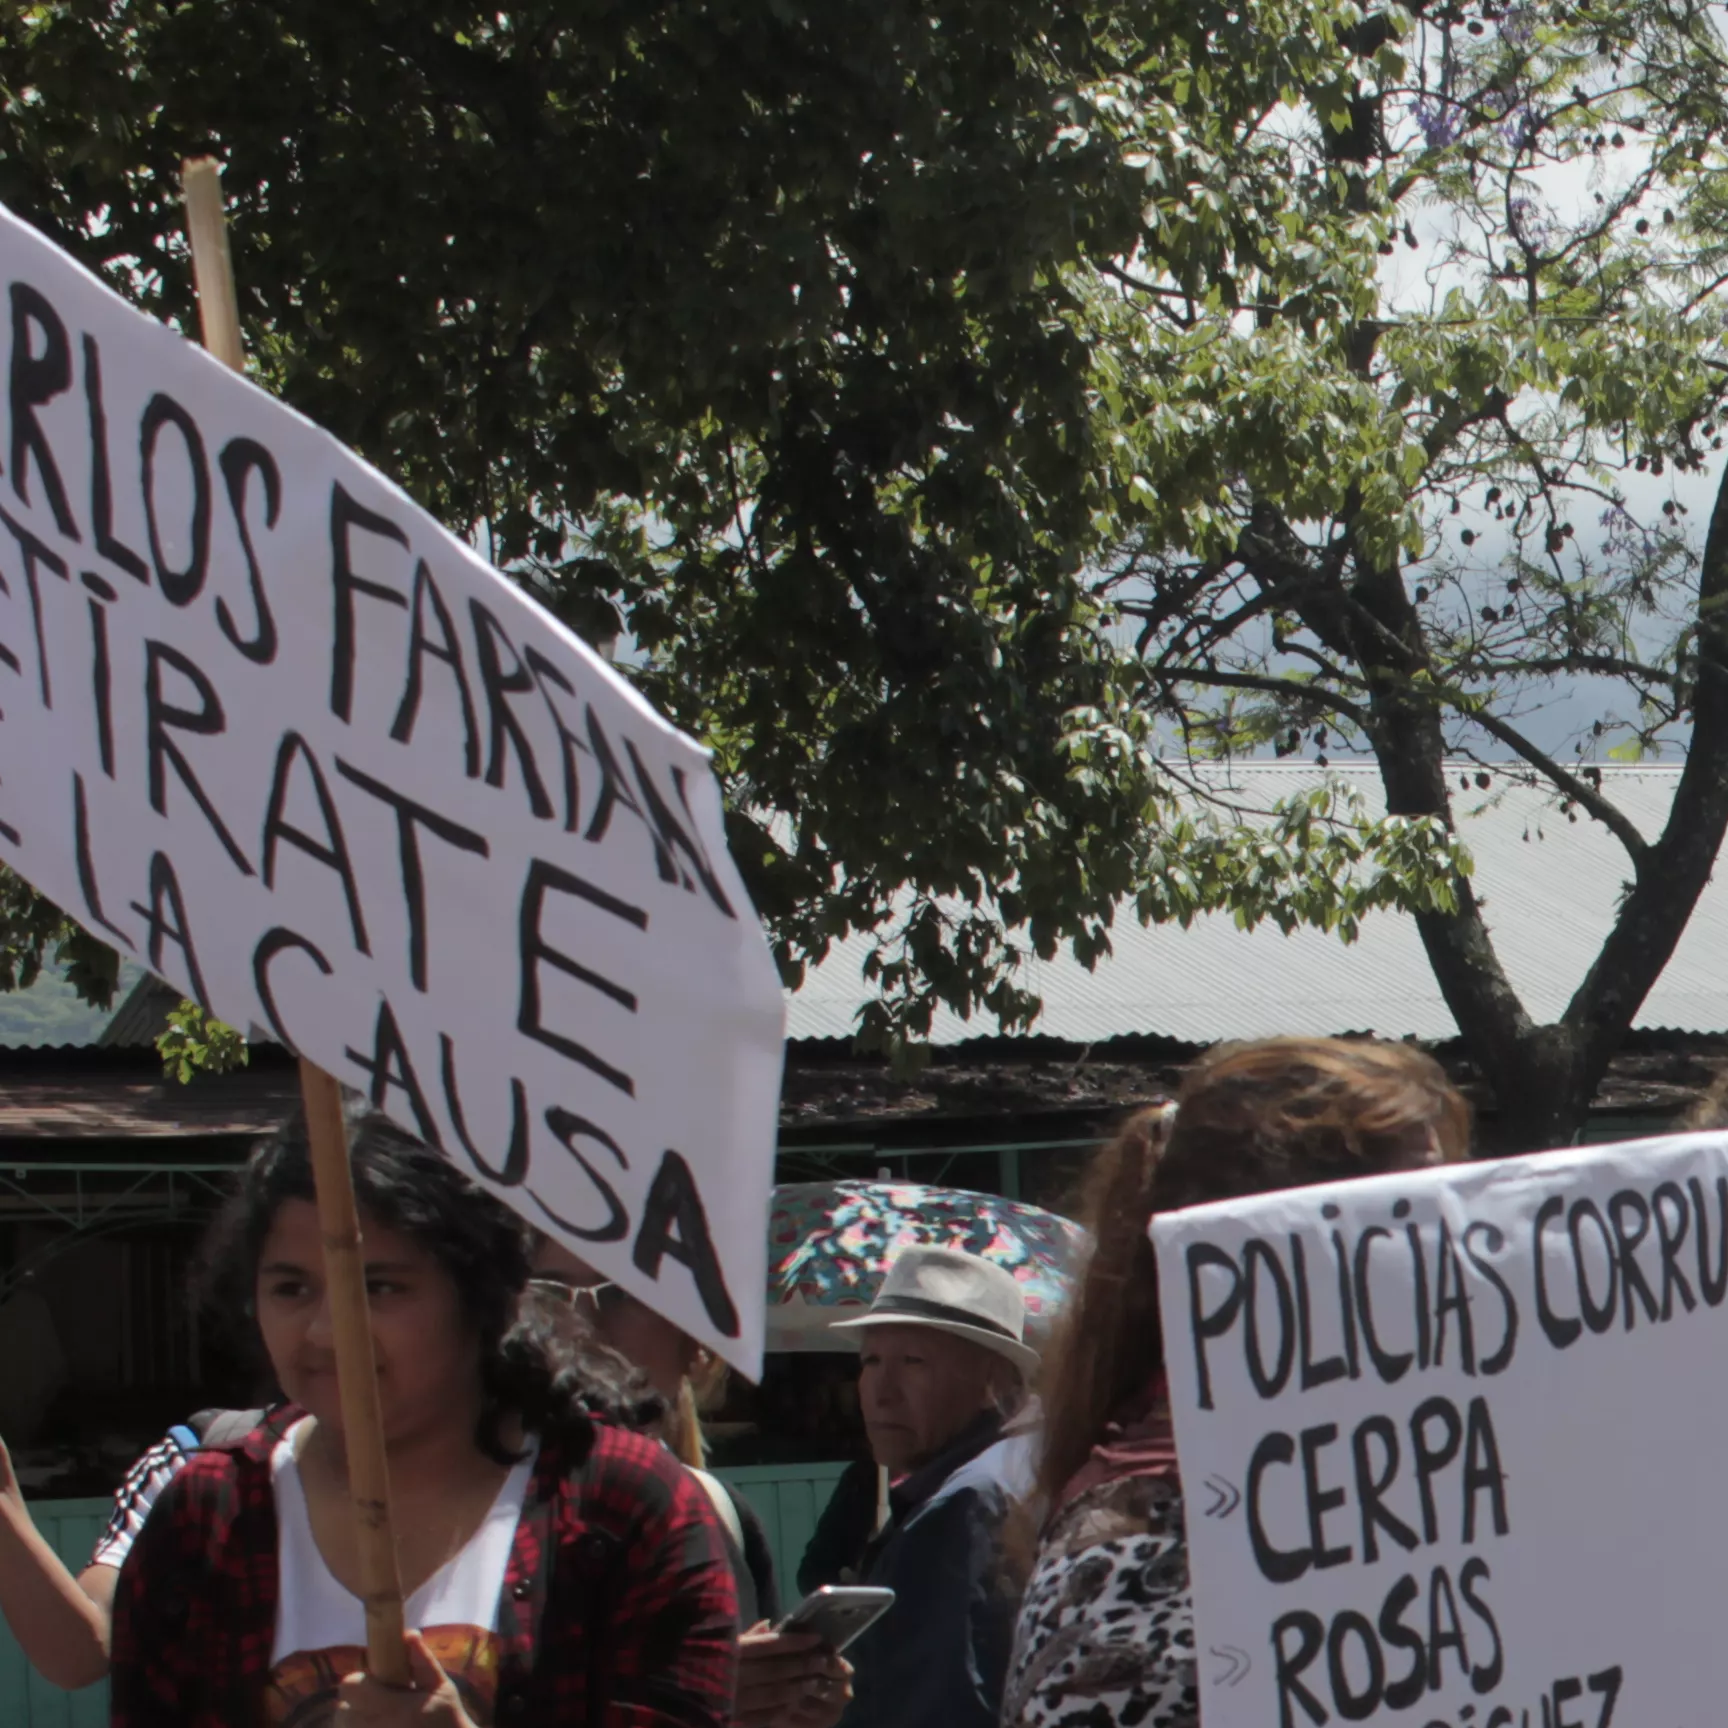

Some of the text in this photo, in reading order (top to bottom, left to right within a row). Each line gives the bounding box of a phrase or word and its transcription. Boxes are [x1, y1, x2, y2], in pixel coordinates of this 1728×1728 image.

[0, 281, 738, 920] RLOS FARFAN
[73, 768, 741, 1340] LA CAUSA
[1246, 1397, 1509, 1583] CERPA
